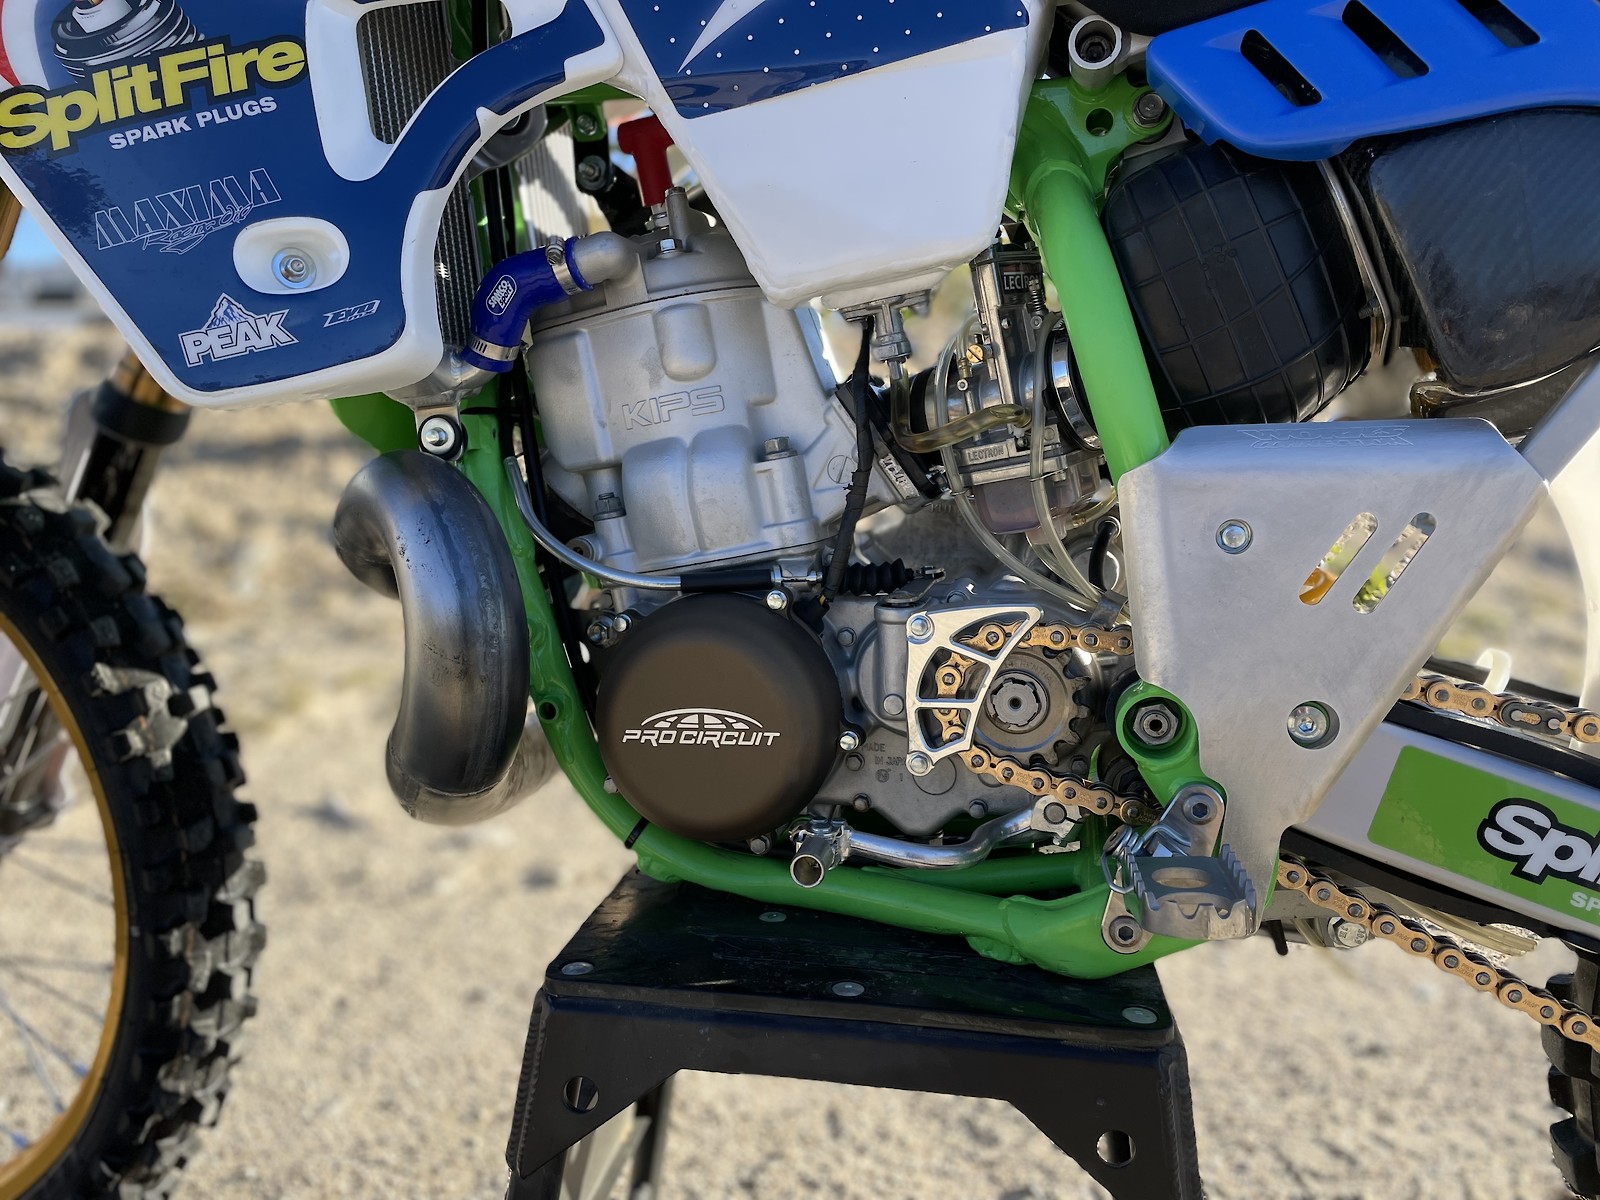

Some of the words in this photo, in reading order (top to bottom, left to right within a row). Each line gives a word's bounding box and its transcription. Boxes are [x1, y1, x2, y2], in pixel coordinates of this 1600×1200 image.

[0, 41, 305, 151] SplitFire
[109, 116, 192, 150] SPARK
[196, 96, 278, 128] PLUGS
[95, 168, 281, 250] MAXIMA
[179, 309, 299, 367] PEAK
[622, 385, 725, 430] KIPS
[967, 446, 1004, 461] LECTRON
[622, 729, 677, 747] PRO
[679, 730, 781, 748] CIRCUIT
[862, 742, 886, 752] MADE
